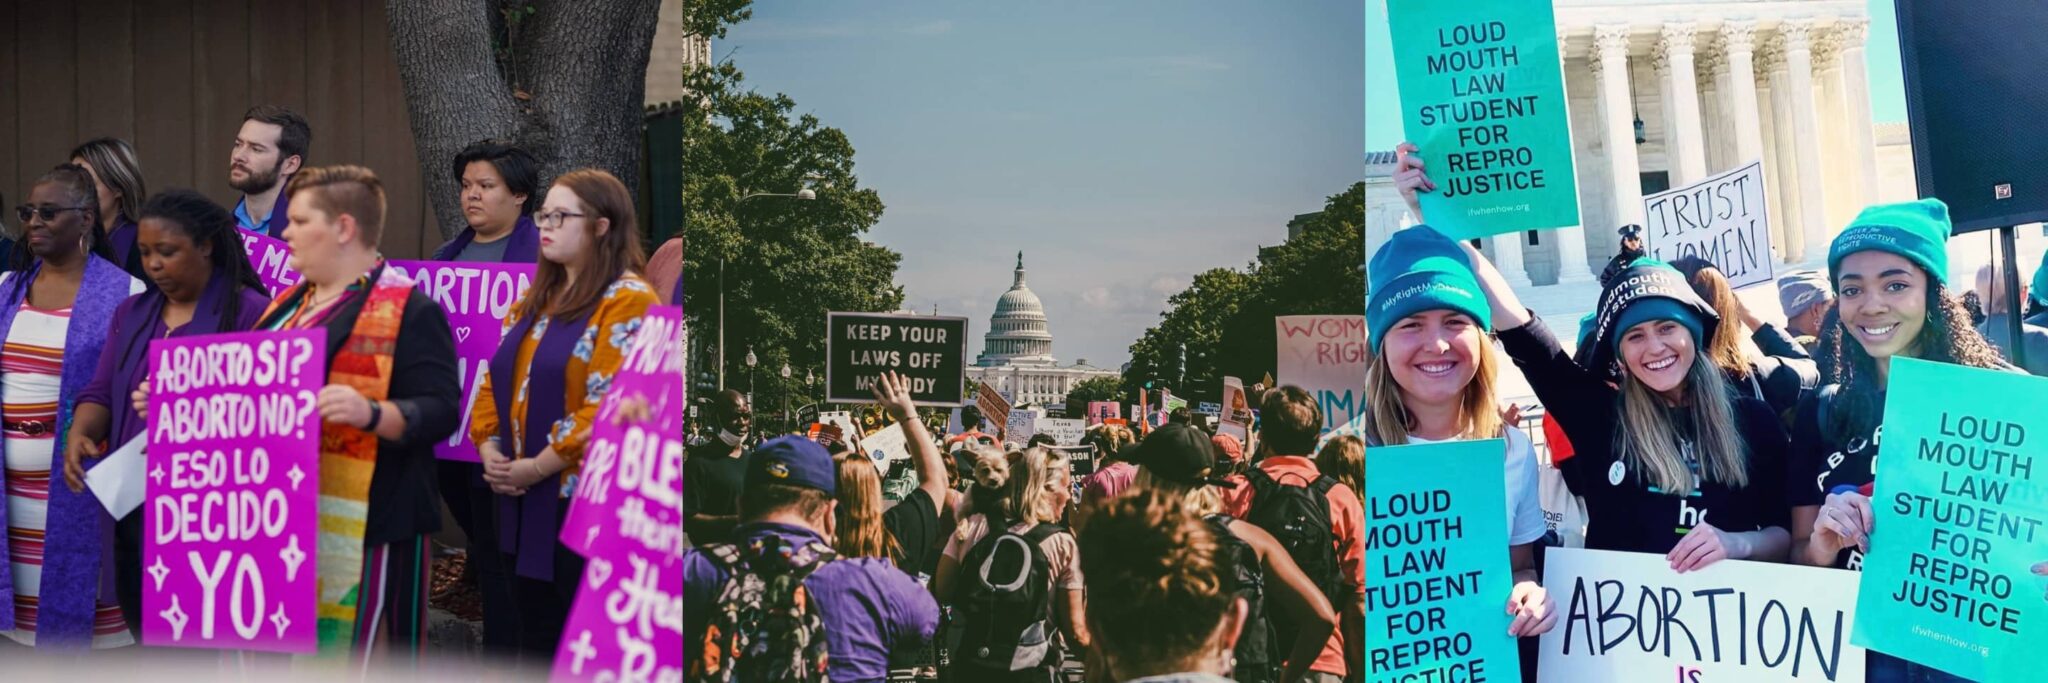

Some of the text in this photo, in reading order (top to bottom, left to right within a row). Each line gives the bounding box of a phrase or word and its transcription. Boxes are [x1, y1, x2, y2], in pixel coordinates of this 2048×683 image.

[1439, 21, 1506, 48] LOUD
[1427, 45, 1519, 75] MOUTH
[1452, 72, 1505, 97] LAW
[1420, 95, 1538, 126] STUDENT
[1458, 124, 1509, 147] FOR
[1447, 146, 1533, 173] REPRO
[1443, 169, 1545, 198] JUSTICE
[1468, 203, 1530, 217] ifwhenhow.org
[1650, 174, 1749, 238] TRUST
[1612, 284, 1677, 313] studen
[847, 325, 947, 343] KEEP YOUR
[156, 337, 313, 394] ABORTO SI?
[851, 350, 942, 368] LAWS OFF
[855, 375, 880, 391] MY
[154, 390, 316, 443] ABORTO NO?
[1939, 412, 2025, 447] LOUD
[171, 447, 270, 489] ESO LO
[617, 426, 683, 509] BLE
[1917, 437, 2032, 480] MOUTH
[1371, 489, 1451, 520] LOUD
[1941, 471, 2009, 505] LAW
[155, 488, 288, 545] DECIDO
[1893, 492, 2042, 543] STUDENT
[1383, 547, 1446, 578] LAW
[1931, 528, 1991, 564] FOR
[1909, 552, 2012, 600] REPRO
[187, 550, 266, 640] YO
[1892, 580, 2021, 634] JUSTICE
[1386, 607, 1446, 639] FOR
[1562, 576, 1843, 682] ABORTION
[1912, 623, 1990, 657] ifwhenhow.org
[1371, 632, 1472, 674] REPRO
[1376, 658, 1486, 683] TICE
